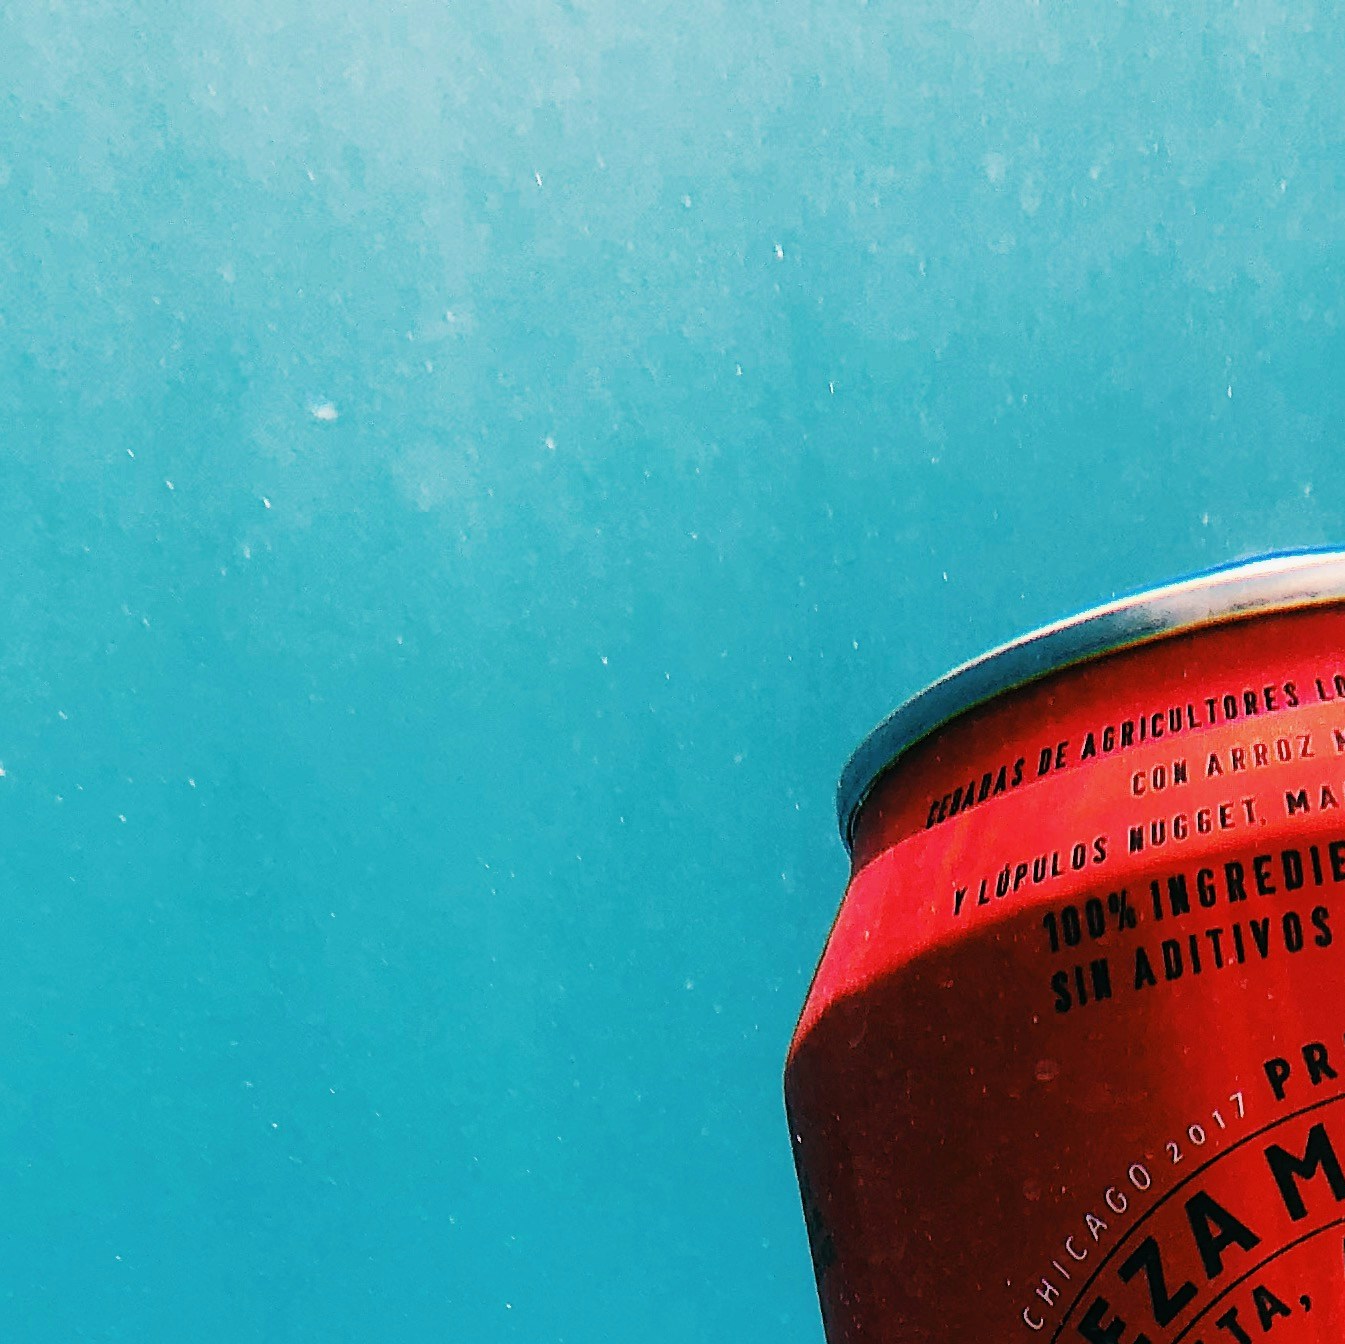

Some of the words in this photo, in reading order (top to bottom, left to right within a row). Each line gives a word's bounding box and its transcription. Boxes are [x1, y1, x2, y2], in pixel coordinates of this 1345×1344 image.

[1037, 740, 1069, 777] DE
[1080, 678, 1300, 761] AGRICULTORES
[1131, 759, 1189, 797] CON
[1205, 734, 1315, 780] ARROZ
[952, 886, 968, 916] Y
[977, 836, 1109, 906] LÚPULOS
[1042, 888, 1137, 952] 100%
[1050, 958, 1112, 1013] SIN
[1134, 906, 1333, 991] ADITIVOS
[1023, 1163, 1151, 1330] CHICAGO
[1166, 1092, 1244, 1163] 2017
